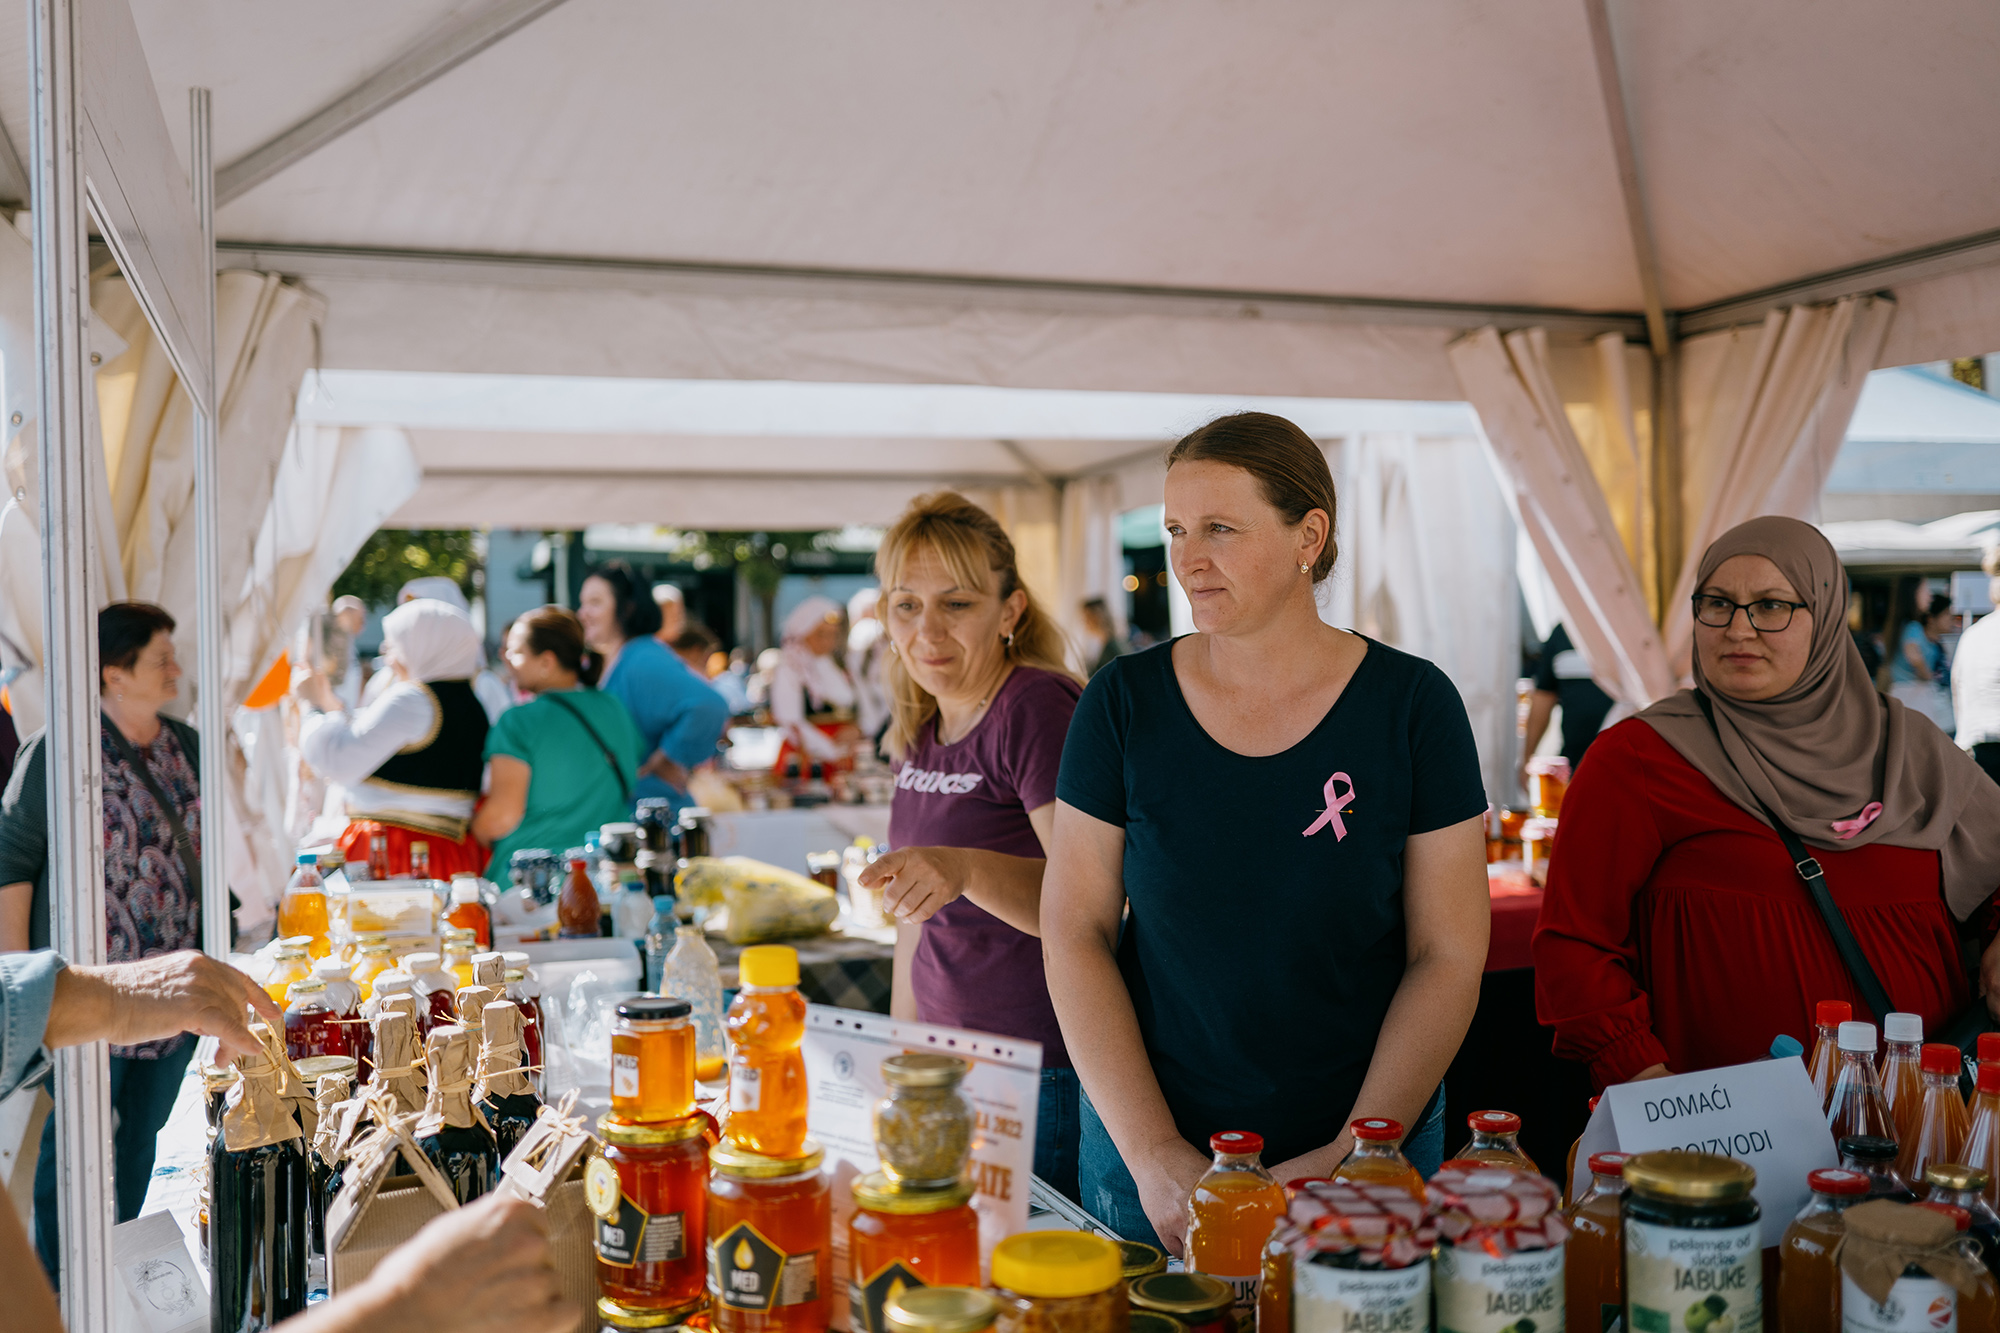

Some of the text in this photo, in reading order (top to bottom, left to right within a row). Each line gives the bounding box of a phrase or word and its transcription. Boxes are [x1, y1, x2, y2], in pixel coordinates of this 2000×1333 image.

[1644, 1084, 1732, 1122] DOMAĆI
[731, 1269, 760, 1292] MED
[1674, 1265, 1746, 1291] JABUKE
[1487, 1287, 1554, 1315] JABUKE
